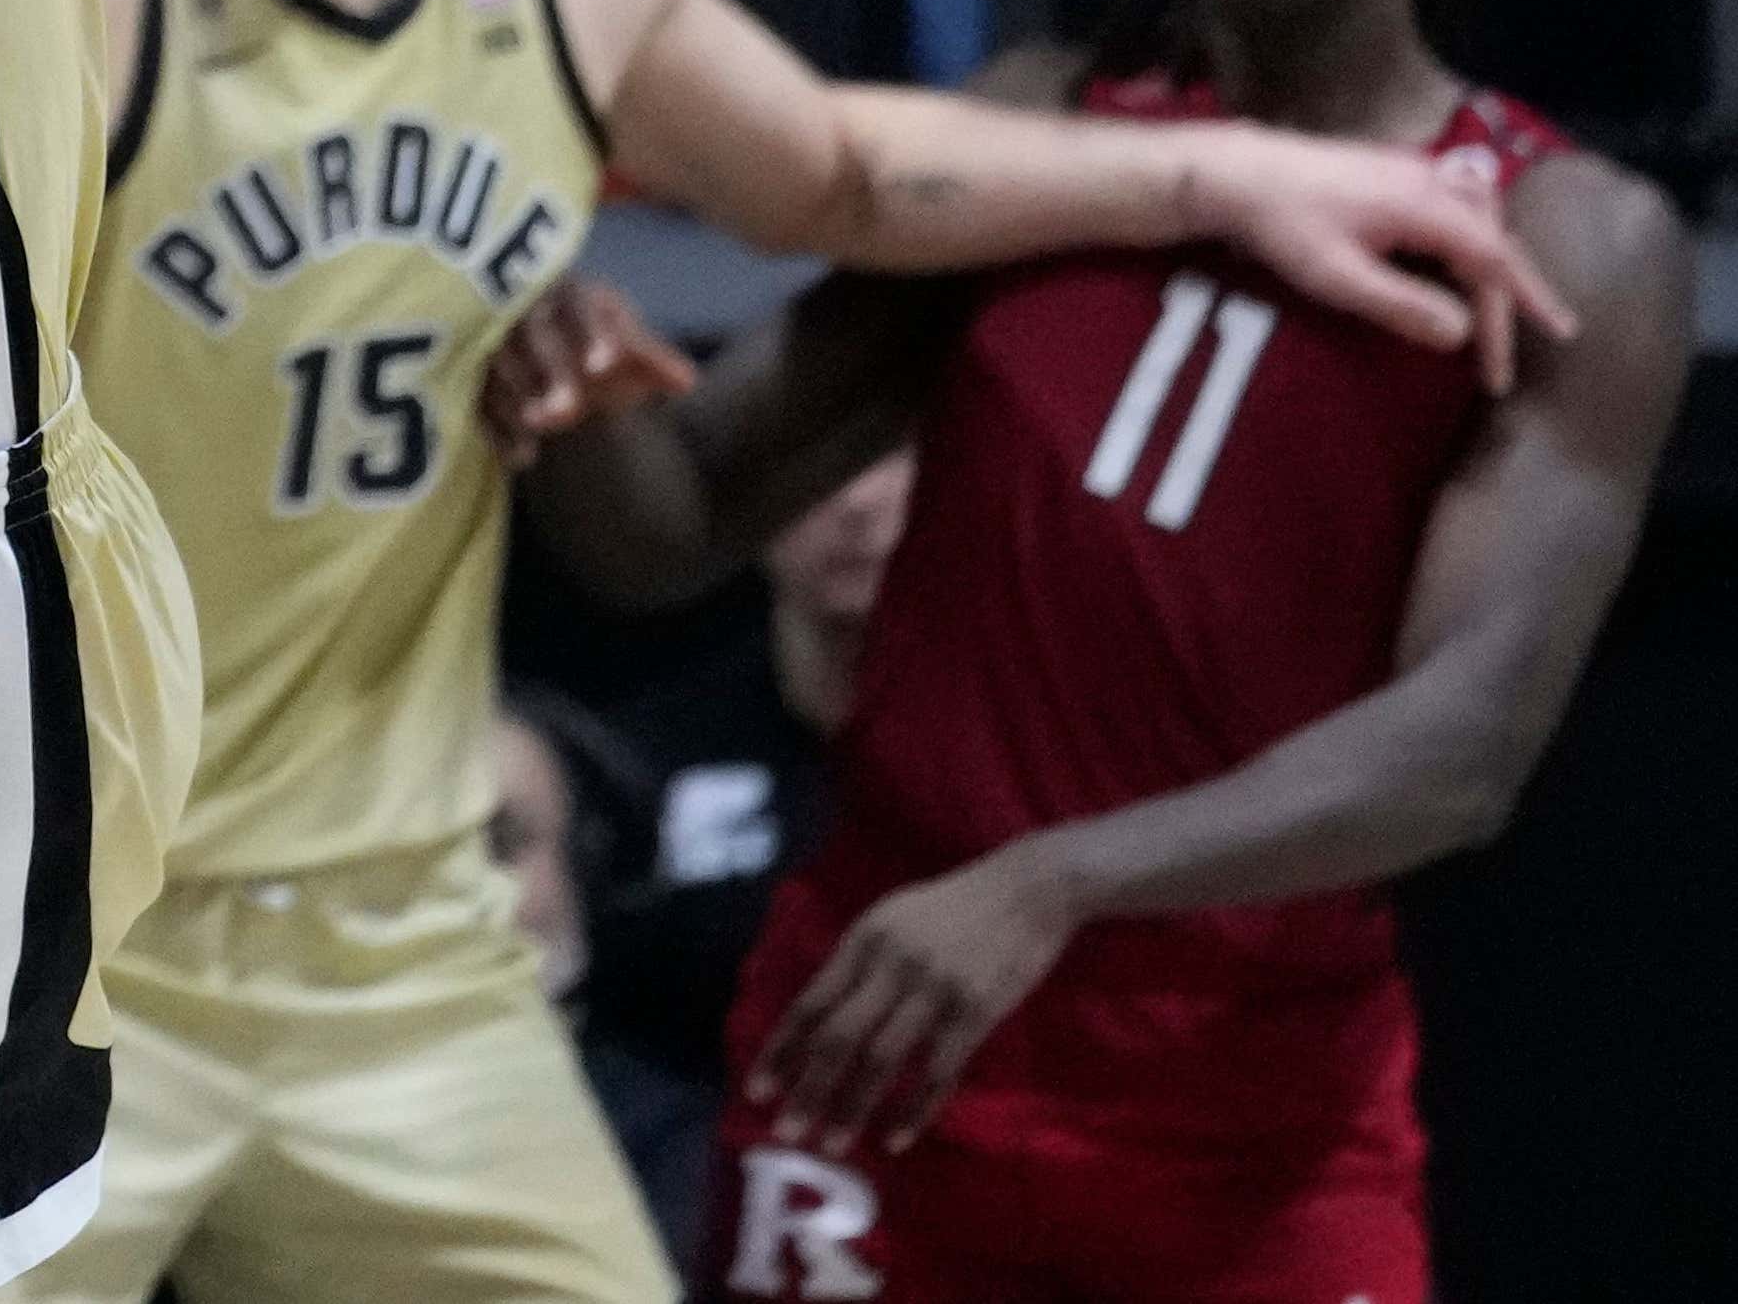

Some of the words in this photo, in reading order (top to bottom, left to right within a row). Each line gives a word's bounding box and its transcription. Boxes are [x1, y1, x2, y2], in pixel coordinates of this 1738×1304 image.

[143, 120, 559, 326] PURDUE
[276, 330, 436, 505] 15
[1081, 268, 1280, 532] 11
[725, 1146, 885, 1300] R
